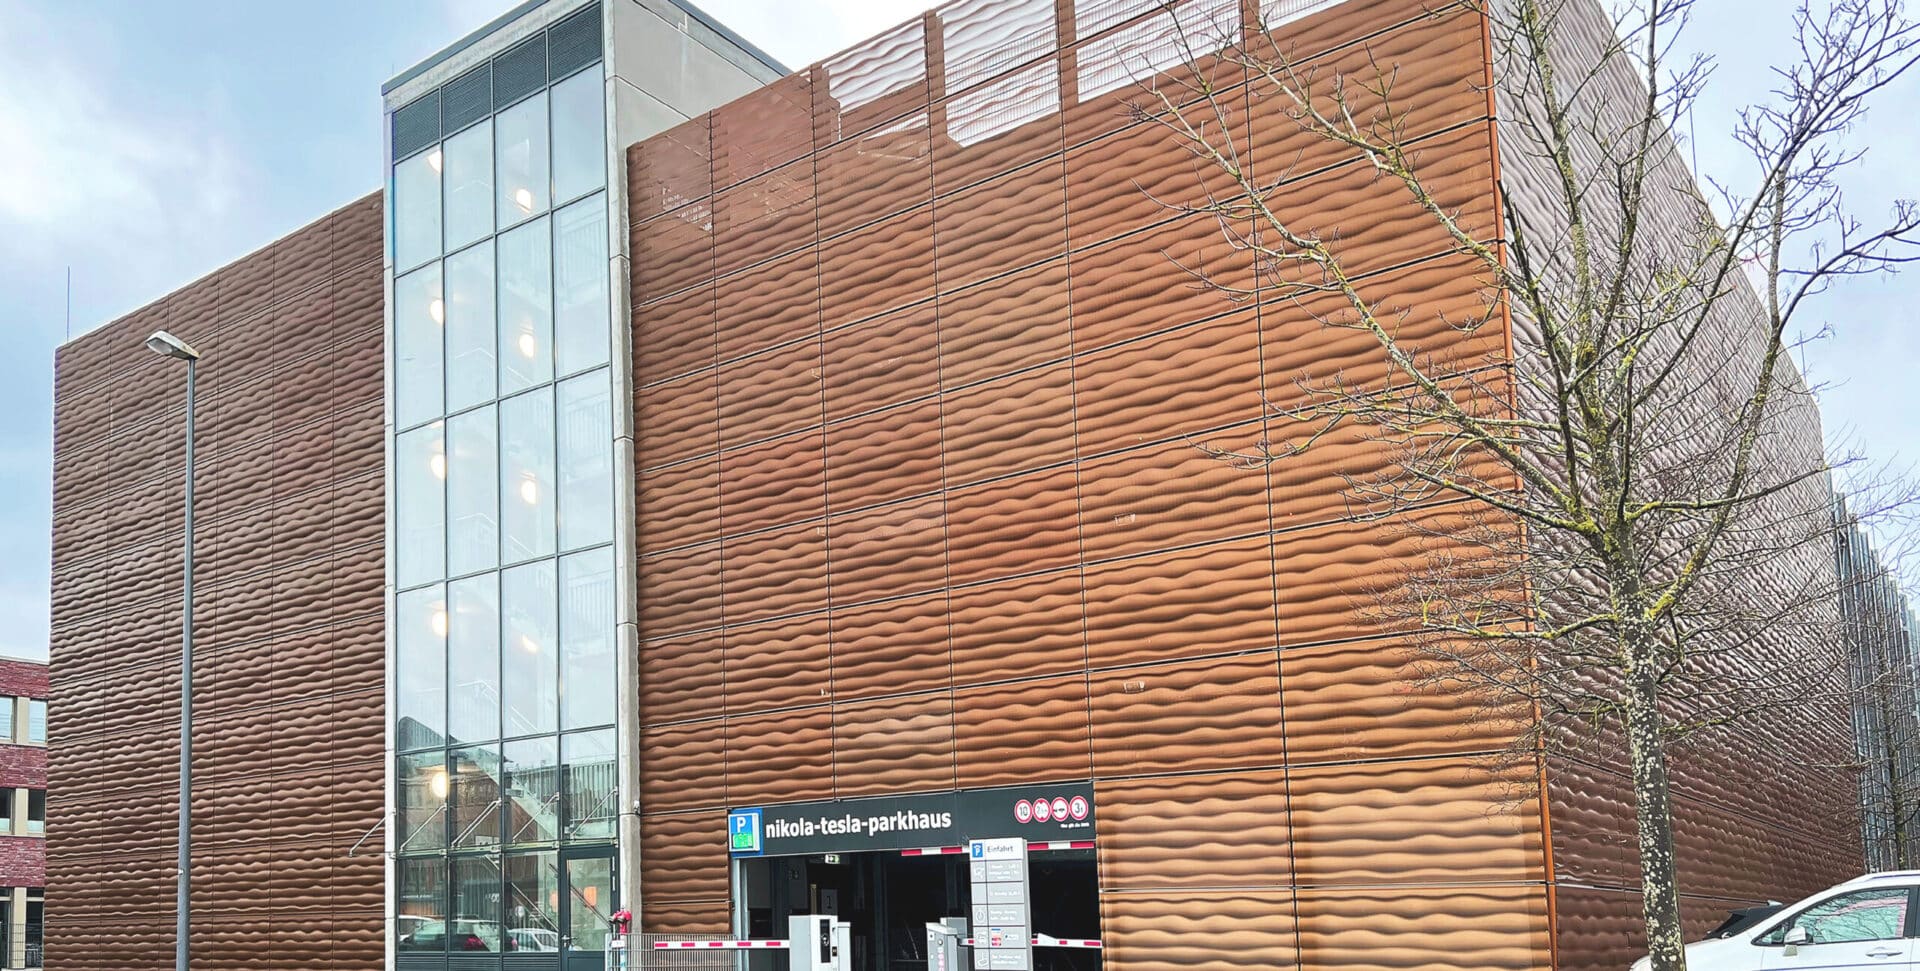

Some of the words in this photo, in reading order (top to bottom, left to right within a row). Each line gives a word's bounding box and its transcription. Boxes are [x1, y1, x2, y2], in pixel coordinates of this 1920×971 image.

[1019, 806, 1029, 817] 10
[736, 816, 747, 834] P
[765, 809, 952, 839] nikola-tesla-parkhaus
